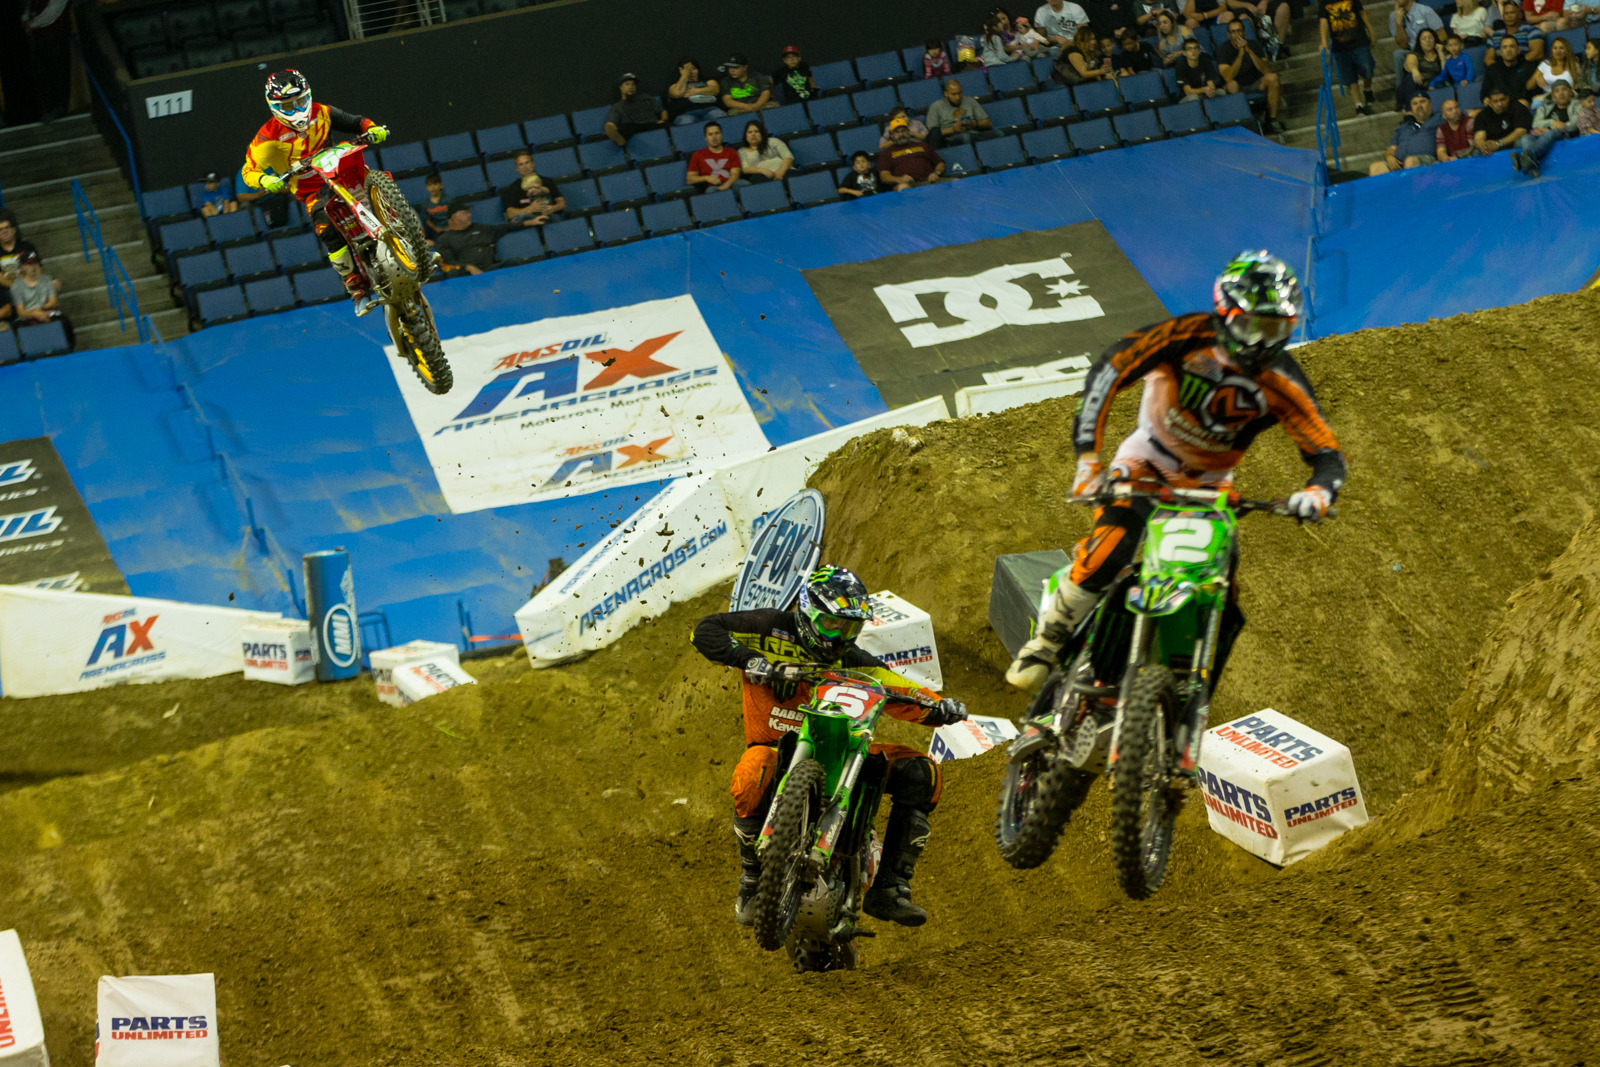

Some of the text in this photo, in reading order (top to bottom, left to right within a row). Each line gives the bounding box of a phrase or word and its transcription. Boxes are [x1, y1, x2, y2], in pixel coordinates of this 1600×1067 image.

[152, 96, 184, 117] 111
[873, 257, 1105, 348] DC
[492, 332, 612, 371] AMSOIL
[452, 330, 684, 421] AX
[432, 365, 718, 438] ARENACROSS
[611, 394, 651, 410] More
[756, 518, 813, 587] FOX
[1158, 518, 1214, 563] 2
[579, 521, 728, 637] ARENACROSS.COM
[85, 614, 160, 667] AX
[242, 642, 287, 658] PARTS
[1215, 726, 1299, 769] UNLIMITED
[1230, 715, 1324, 762] PARTS
[1197, 766, 1272, 824] PARTS
[1284, 787, 1356, 820] PARTS
[1286, 798, 1358, 828] UNLIMITED
[111, 1015, 208, 1031] PARTS
[111, 1030, 208, 1041] UNLIMITED
